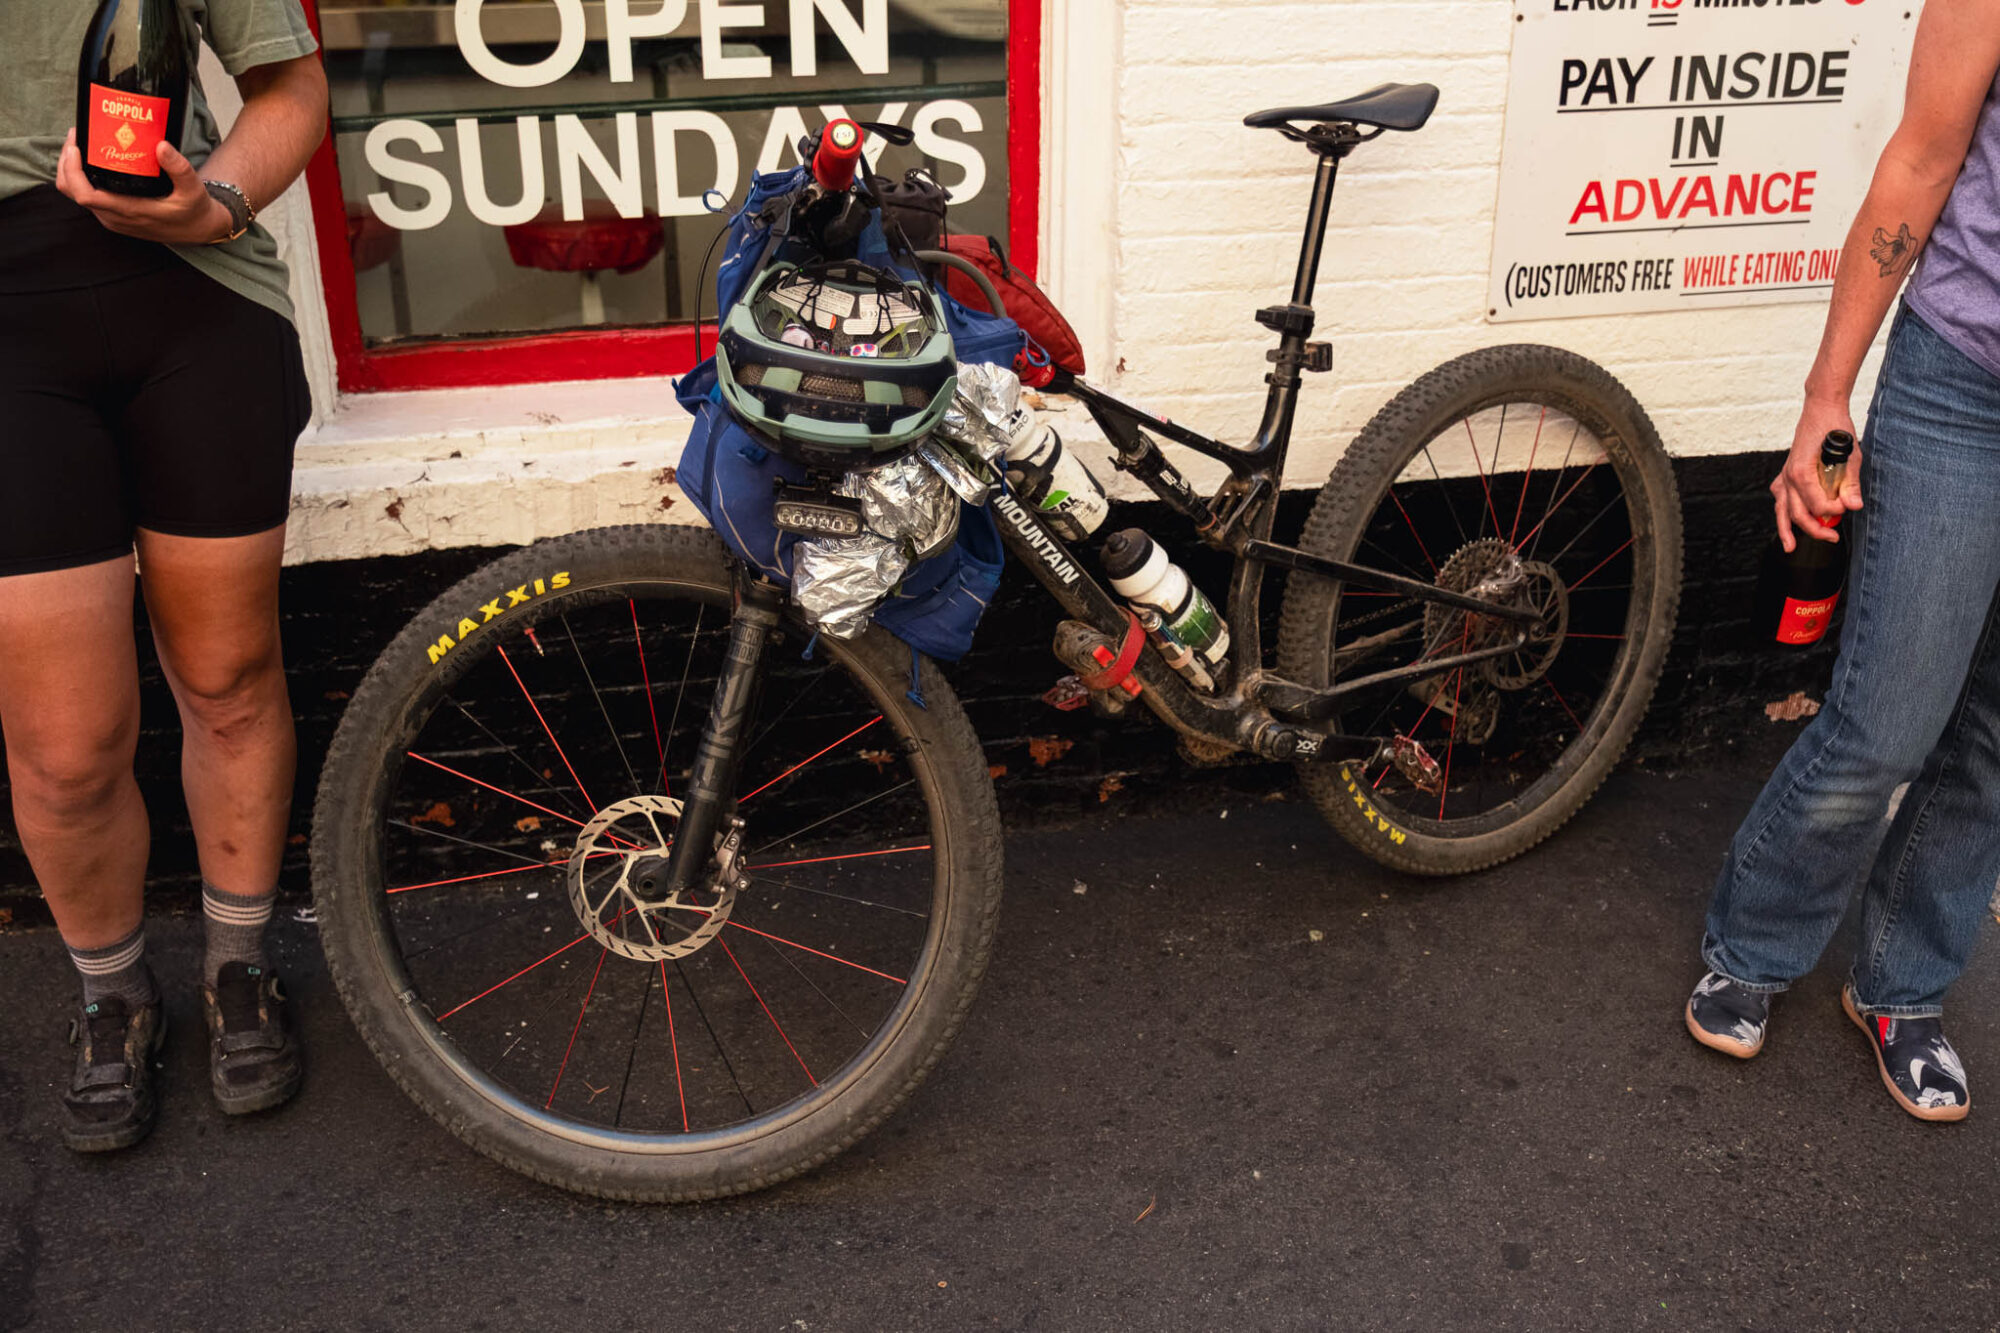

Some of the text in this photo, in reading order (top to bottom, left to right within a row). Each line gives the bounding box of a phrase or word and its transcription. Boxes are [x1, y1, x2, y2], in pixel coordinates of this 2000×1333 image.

[454, 0, 889, 88] OPEN
[1559, 50, 1850, 106] PAY INSIDE
[102, 99, 153, 122] COPPOLA
[1671, 115, 1725, 160] IN
[1568, 171, 1818, 225] ADVANCE
[1631, 258, 1675, 292] FREE
[1683, 254, 1740, 289] WHILE
[1742, 250, 1806, 286] EATING
[1806, 248, 1845, 282] ONL
[993, 493, 1080, 585] MOUNTAIN
[427, 571, 572, 665] MAXXIS
